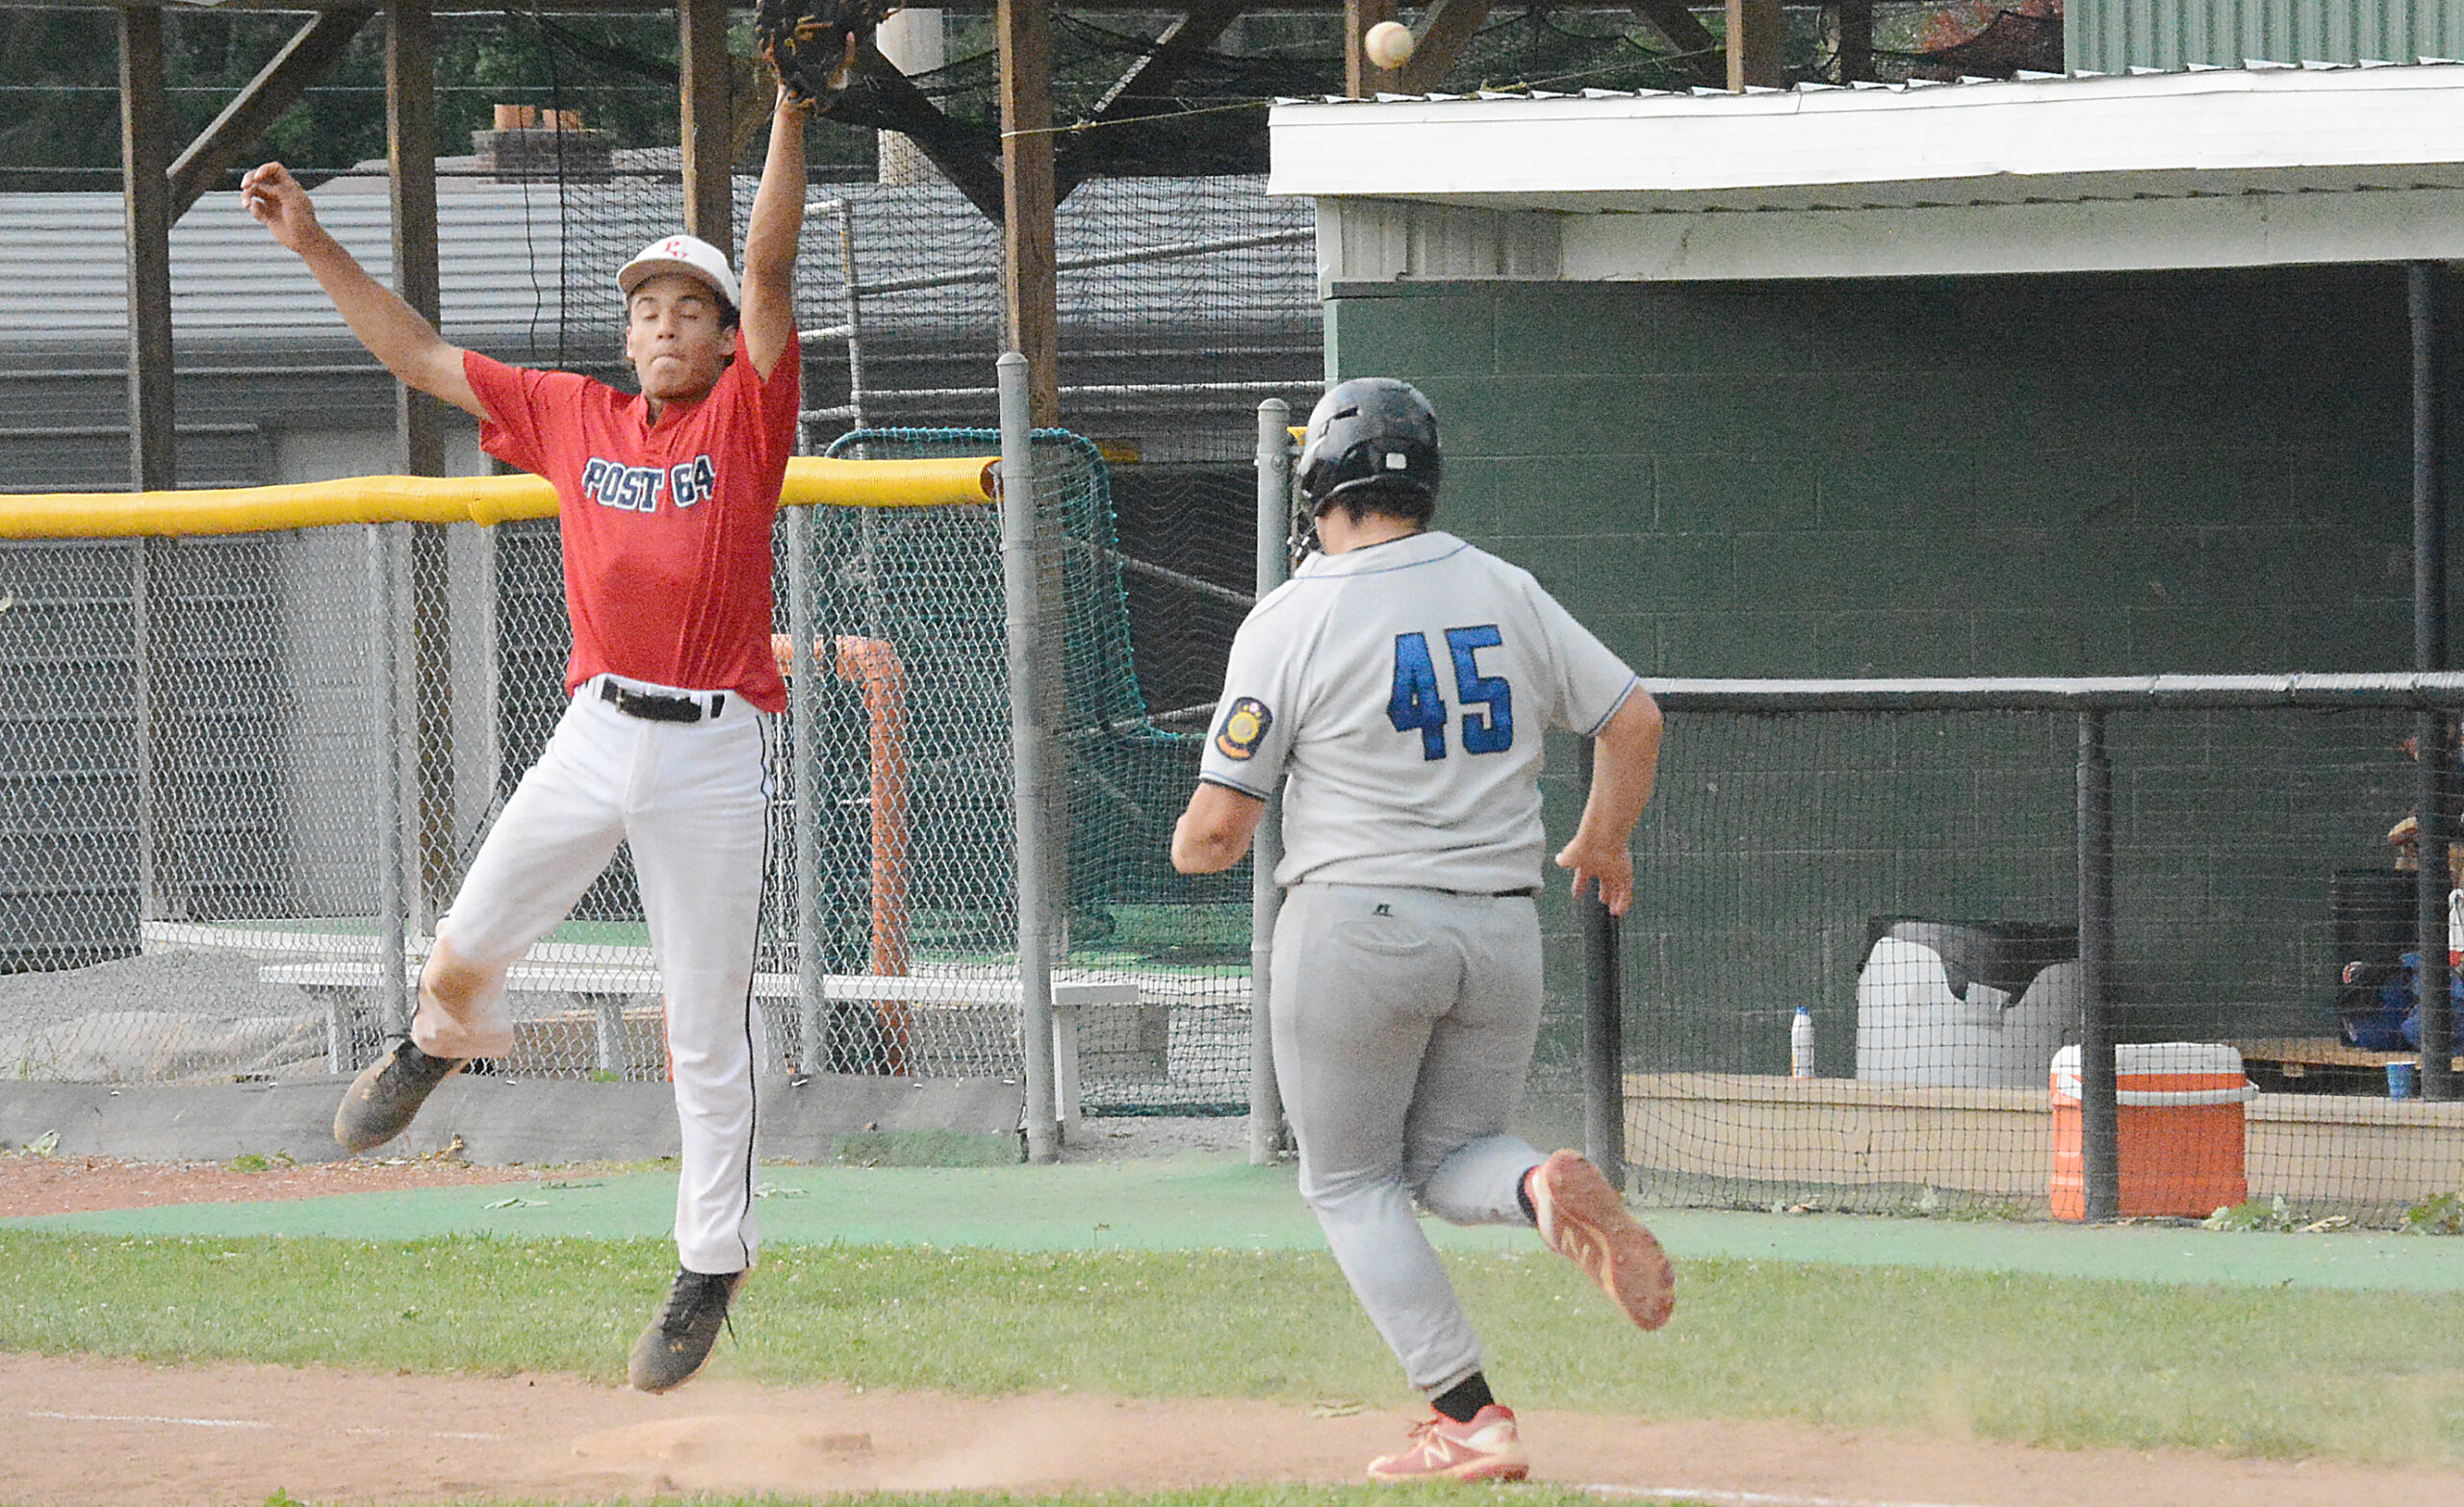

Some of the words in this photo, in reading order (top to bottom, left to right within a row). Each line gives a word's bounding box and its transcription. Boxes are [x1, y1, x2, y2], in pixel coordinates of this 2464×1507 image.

[581, 456, 666, 513] POST
[671, 454, 716, 508] 64
[1386, 624, 1513, 761] 45
